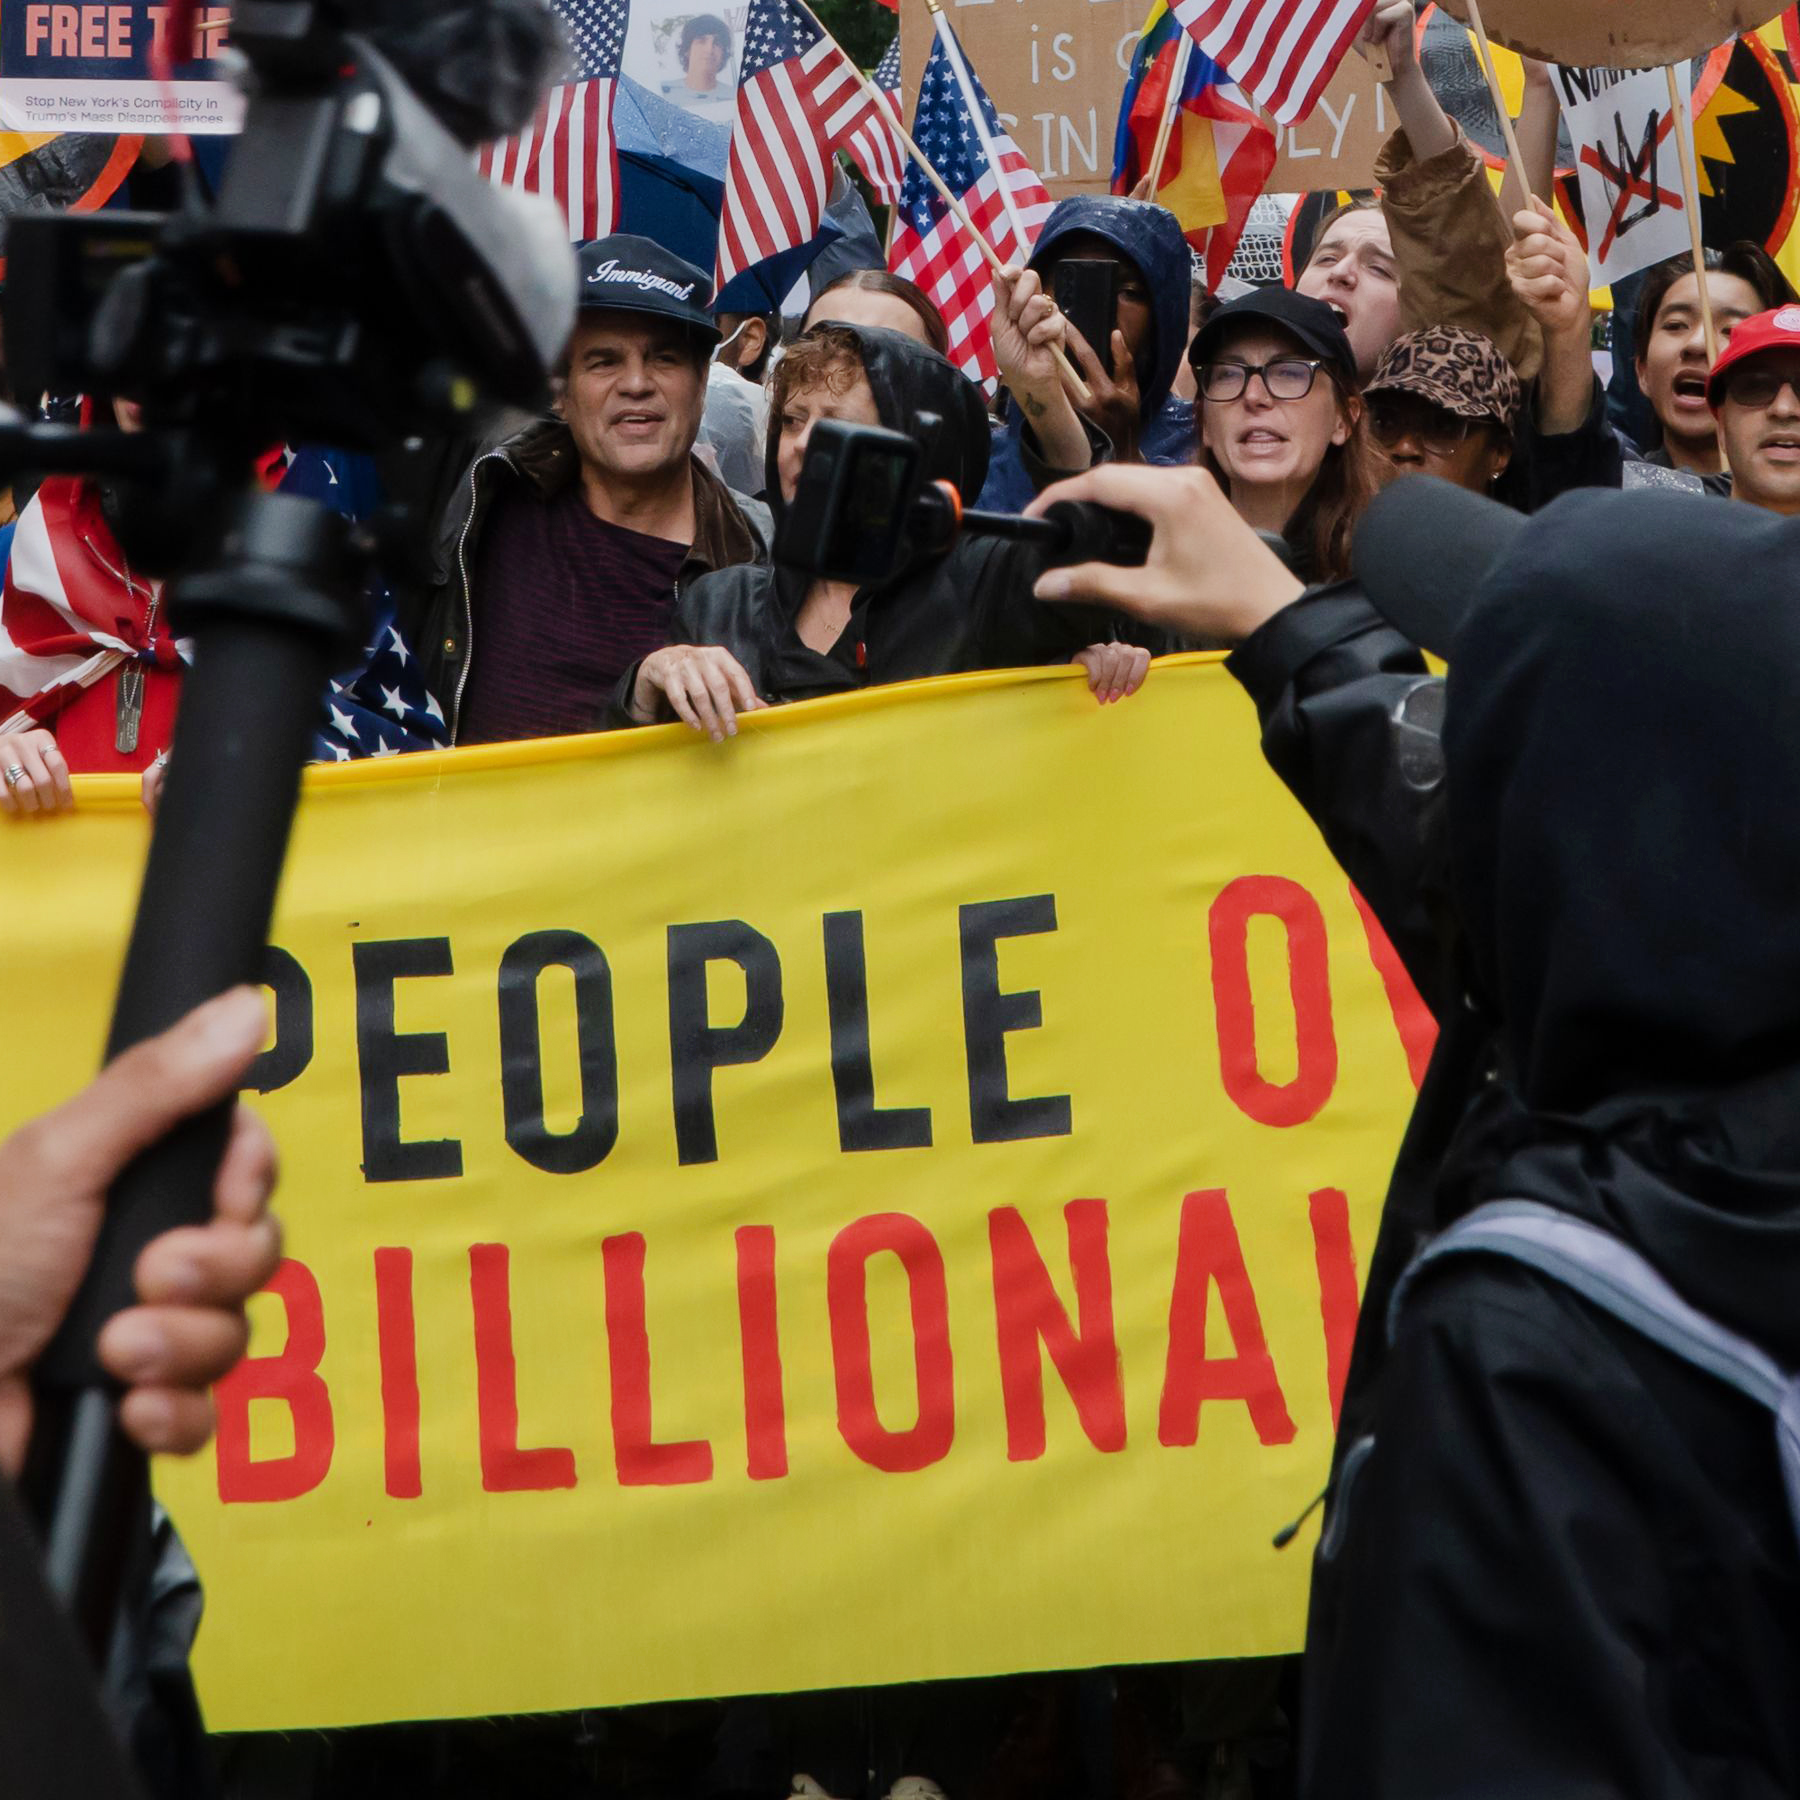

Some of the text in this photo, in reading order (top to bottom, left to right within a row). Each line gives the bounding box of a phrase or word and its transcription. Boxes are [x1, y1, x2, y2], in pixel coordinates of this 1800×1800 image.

[25, 5, 133, 58] FREE
[1030, 25, 1078, 84] is
[25, 95, 218, 111] Stop New York's Complicity in
[26, 111, 223, 124] Trump's Mass Disappearances
[587, 259, 695, 301] Immigrant
